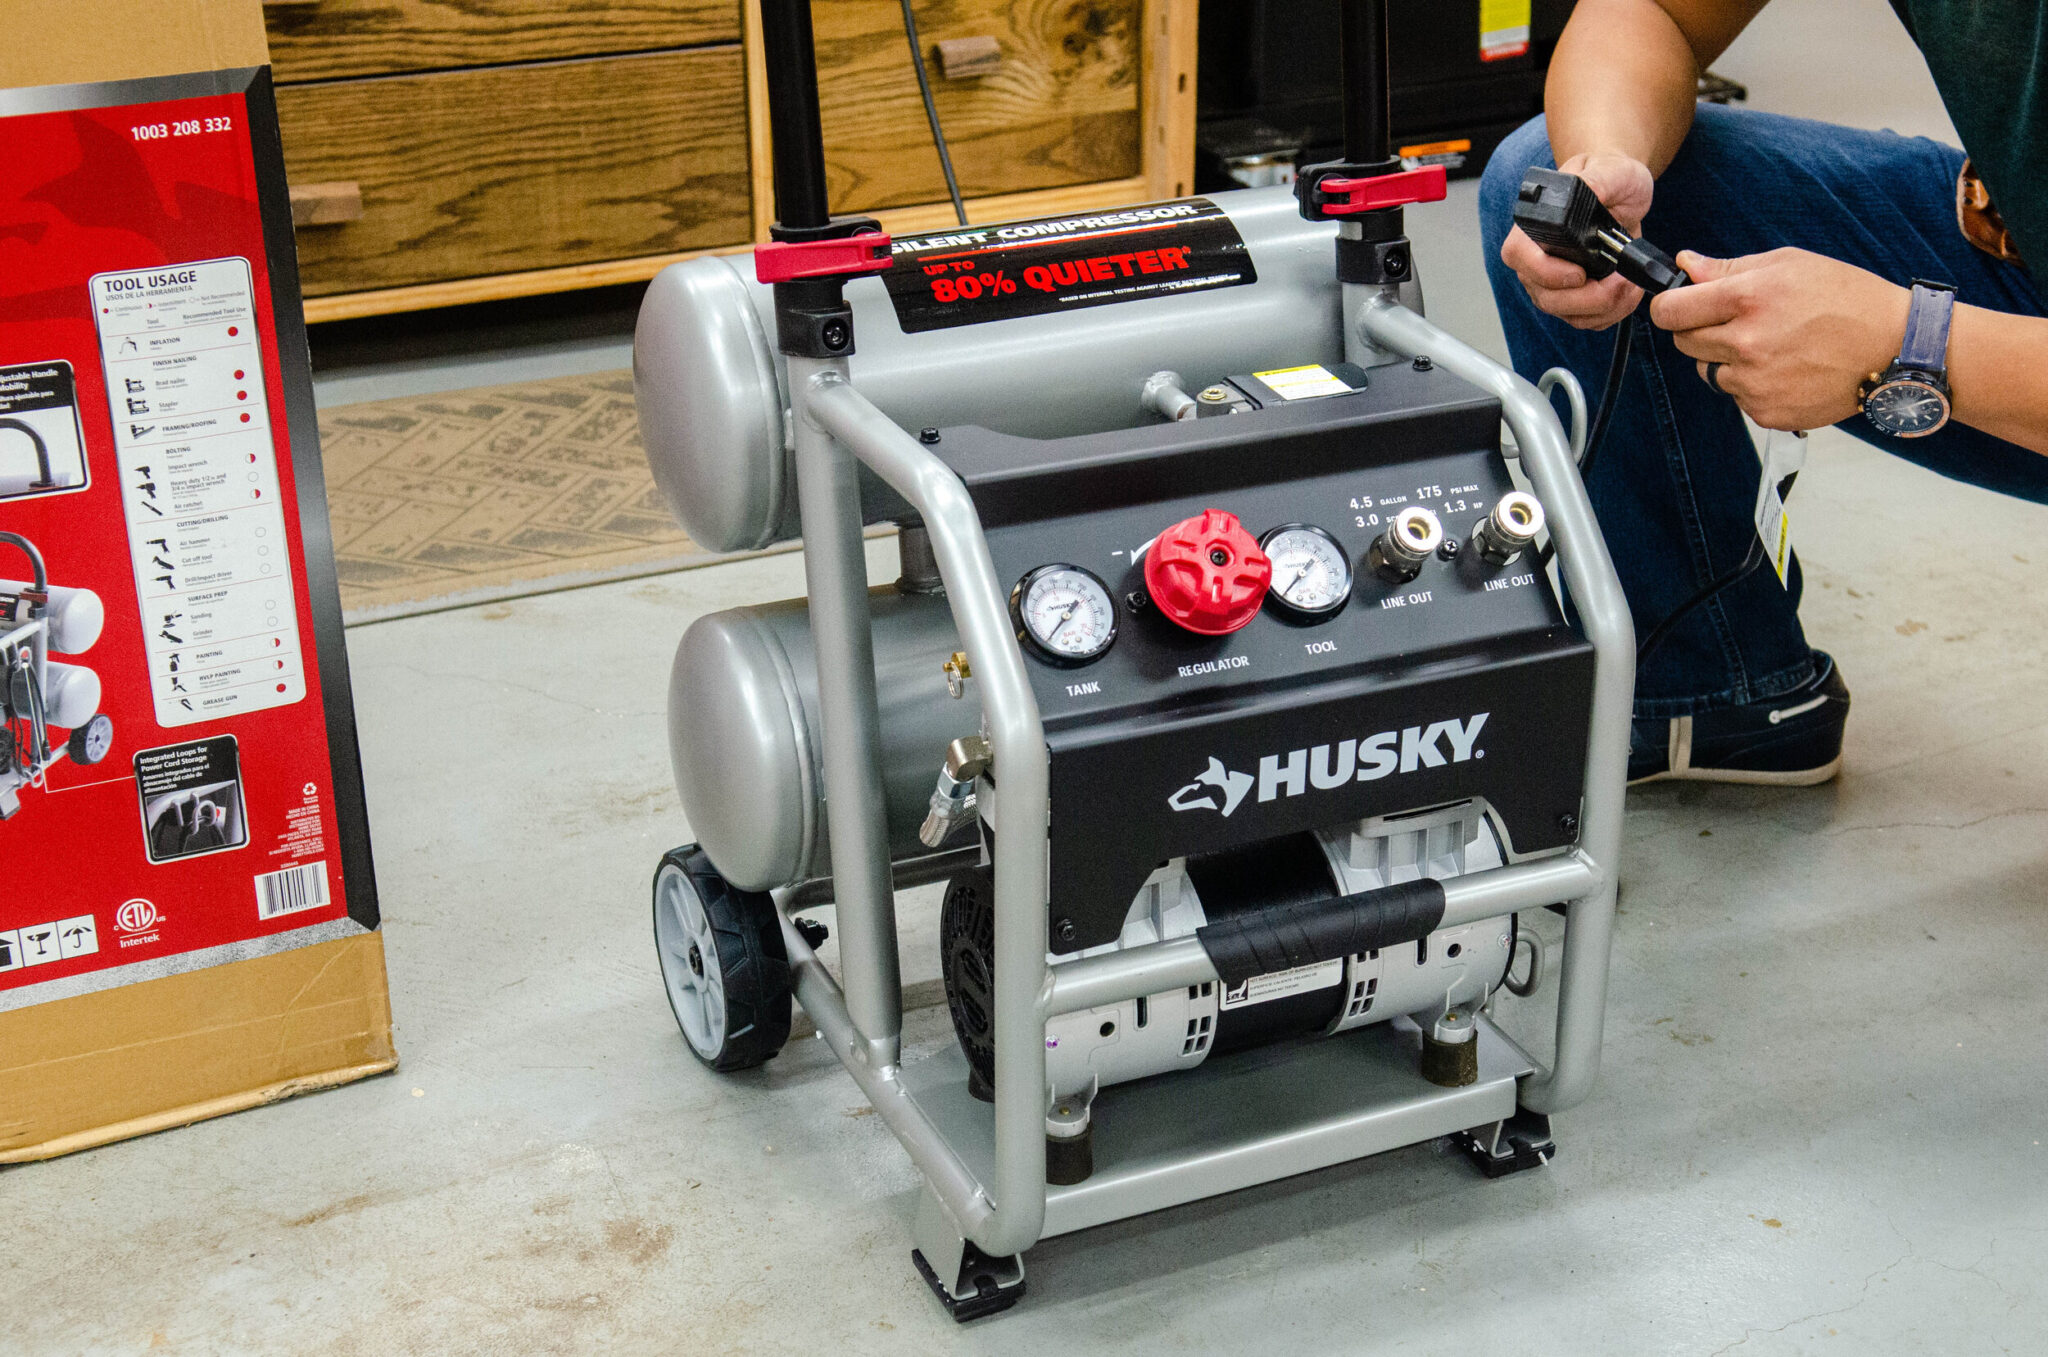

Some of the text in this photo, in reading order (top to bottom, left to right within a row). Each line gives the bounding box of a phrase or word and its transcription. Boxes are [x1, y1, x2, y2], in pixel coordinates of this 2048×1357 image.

[131, 117, 232, 141] 1003 208 332
[892, 205, 1198, 254] SILENT COMPRESSOR
[922, 261, 975, 275] UP TO
[104, 271, 197, 292] TOOL USAGE
[931, 270, 1017, 303] 80%
[146, 285, 193, 297] HERRAMIENTA
[150, 337, 180, 346] INFLATION
[152, 355, 197, 367] FINISH NAILING
[31, 369, 58, 378] Handle
[166, 446, 191, 455] BOLTING
[1350, 484, 1479, 510] 4.5 GALLON 175 PSI MAX
[1355, 514, 1379, 528] 3.0
[1444, 499, 1467, 513] 1.3
[1483, 573, 1535, 592] LINE OUT
[188, 590, 228, 602] SURFACE PREP
[1381, 590, 1433, 609] LINE OUT
[196, 650, 223, 659] PAINTING
[1305, 639, 1338, 656] TOOL
[215, 668, 241, 678] PAINTING
[1178, 655, 1250, 678] REGULATOR
[1065, 680, 1101, 698] TANK
[203, 694, 238, 706] GREASE GUN
[140, 752, 176, 764] Integrated
[176, 749, 196, 758] Loops
[141, 755, 207, 772] Power Cord Storage
[120, 933, 160, 948] Intertek
